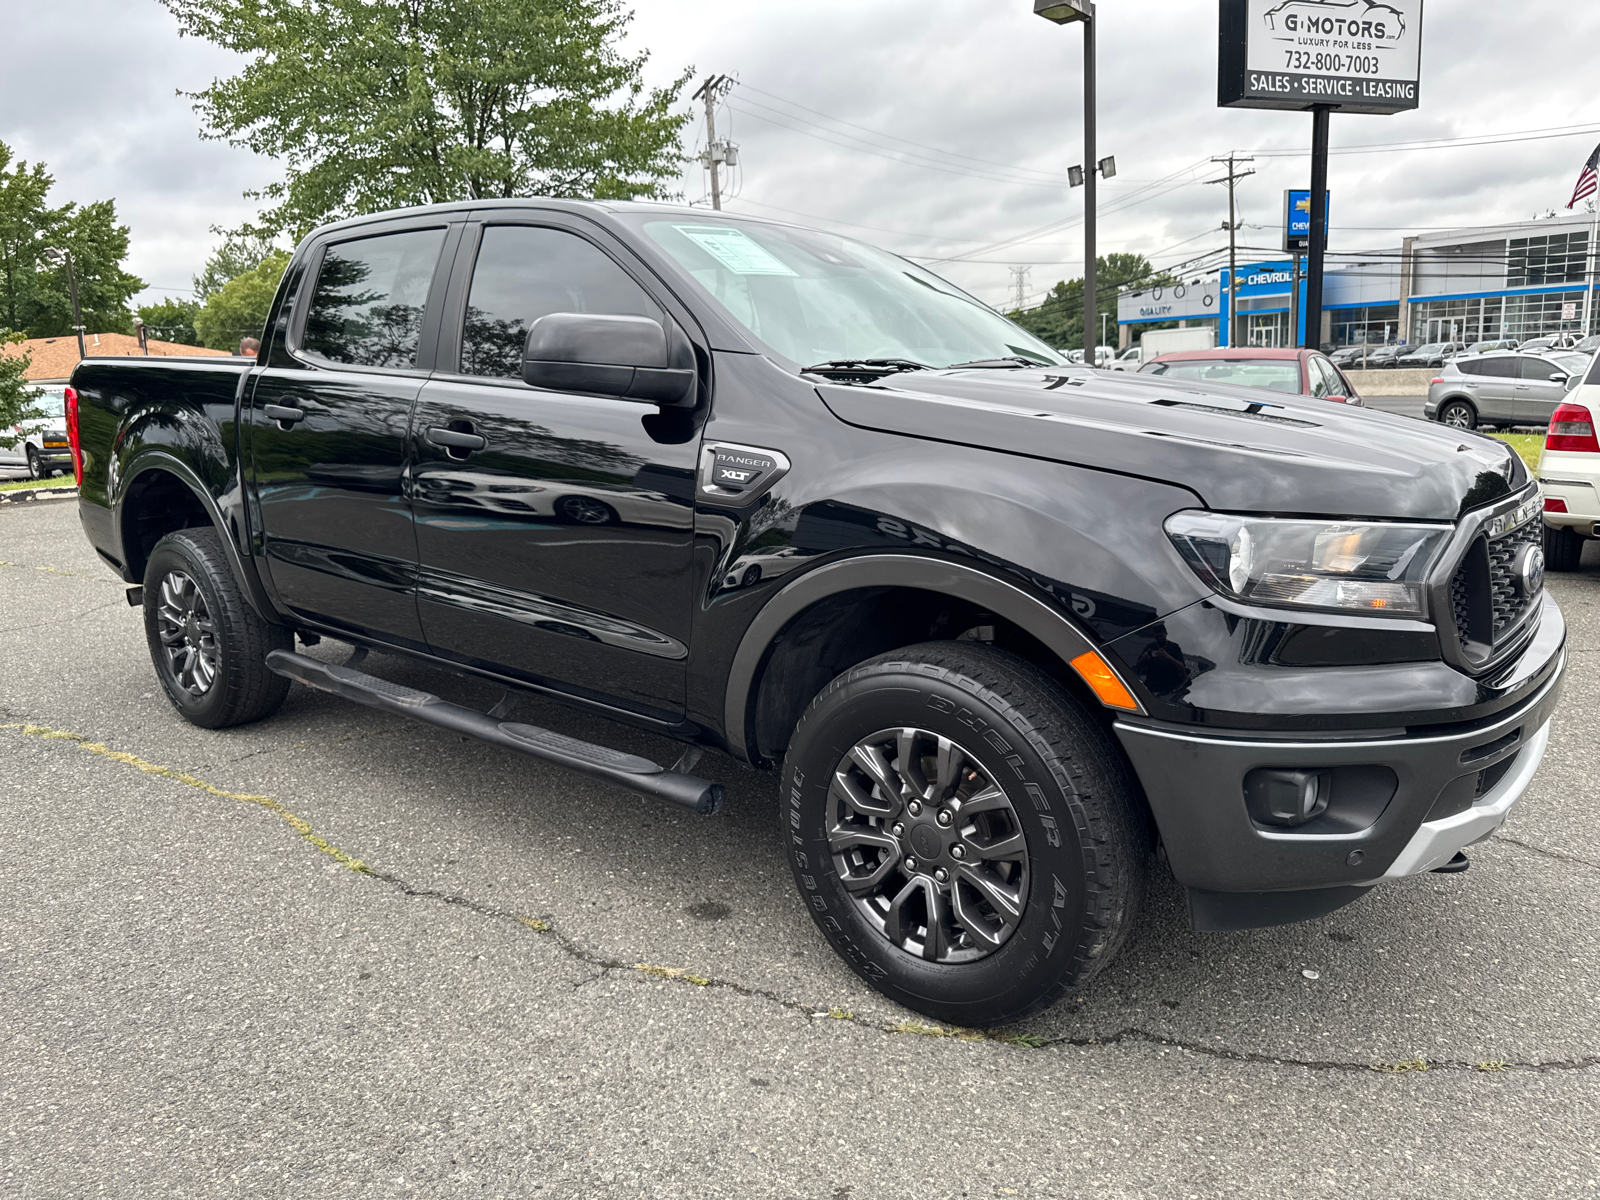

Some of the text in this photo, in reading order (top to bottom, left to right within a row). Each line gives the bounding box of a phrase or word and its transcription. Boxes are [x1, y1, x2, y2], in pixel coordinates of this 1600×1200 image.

[1297, 37, 1372, 51] LUXURY FOR LESS
[1284, 50, 1379, 75] 732-800-7003
[1250, 74, 1414, 99] SALES SERVICE LEASING
[1247, 270, 1307, 286] CHEVROL
[1140, 305, 1172, 316] QUALITY
[716, 454, 771, 468] RANGER
[720, 469, 750, 481] XLT
